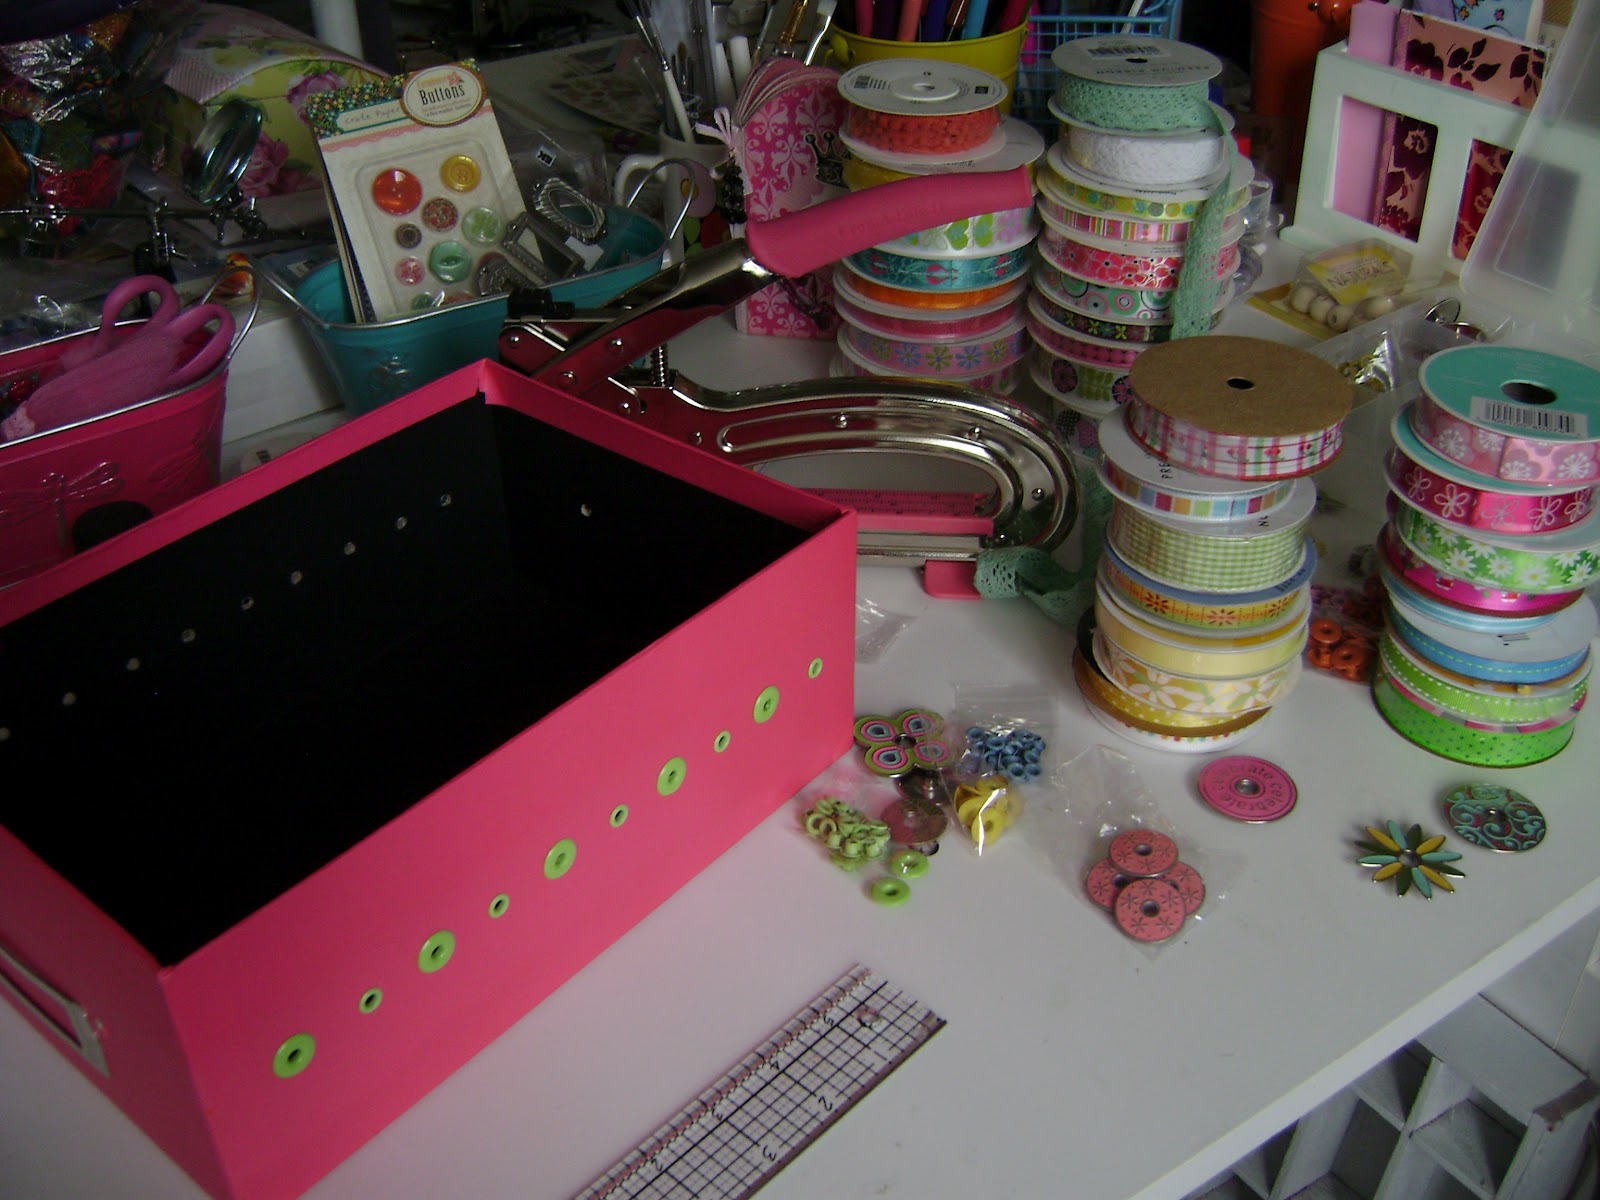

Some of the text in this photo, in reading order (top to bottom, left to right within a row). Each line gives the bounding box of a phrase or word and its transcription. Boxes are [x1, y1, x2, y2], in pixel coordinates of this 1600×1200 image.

[419, 84, 466, 106] Buttons
[818, 1095, 833, 1112] 2
[762, 1144, 777, 1162] 3
